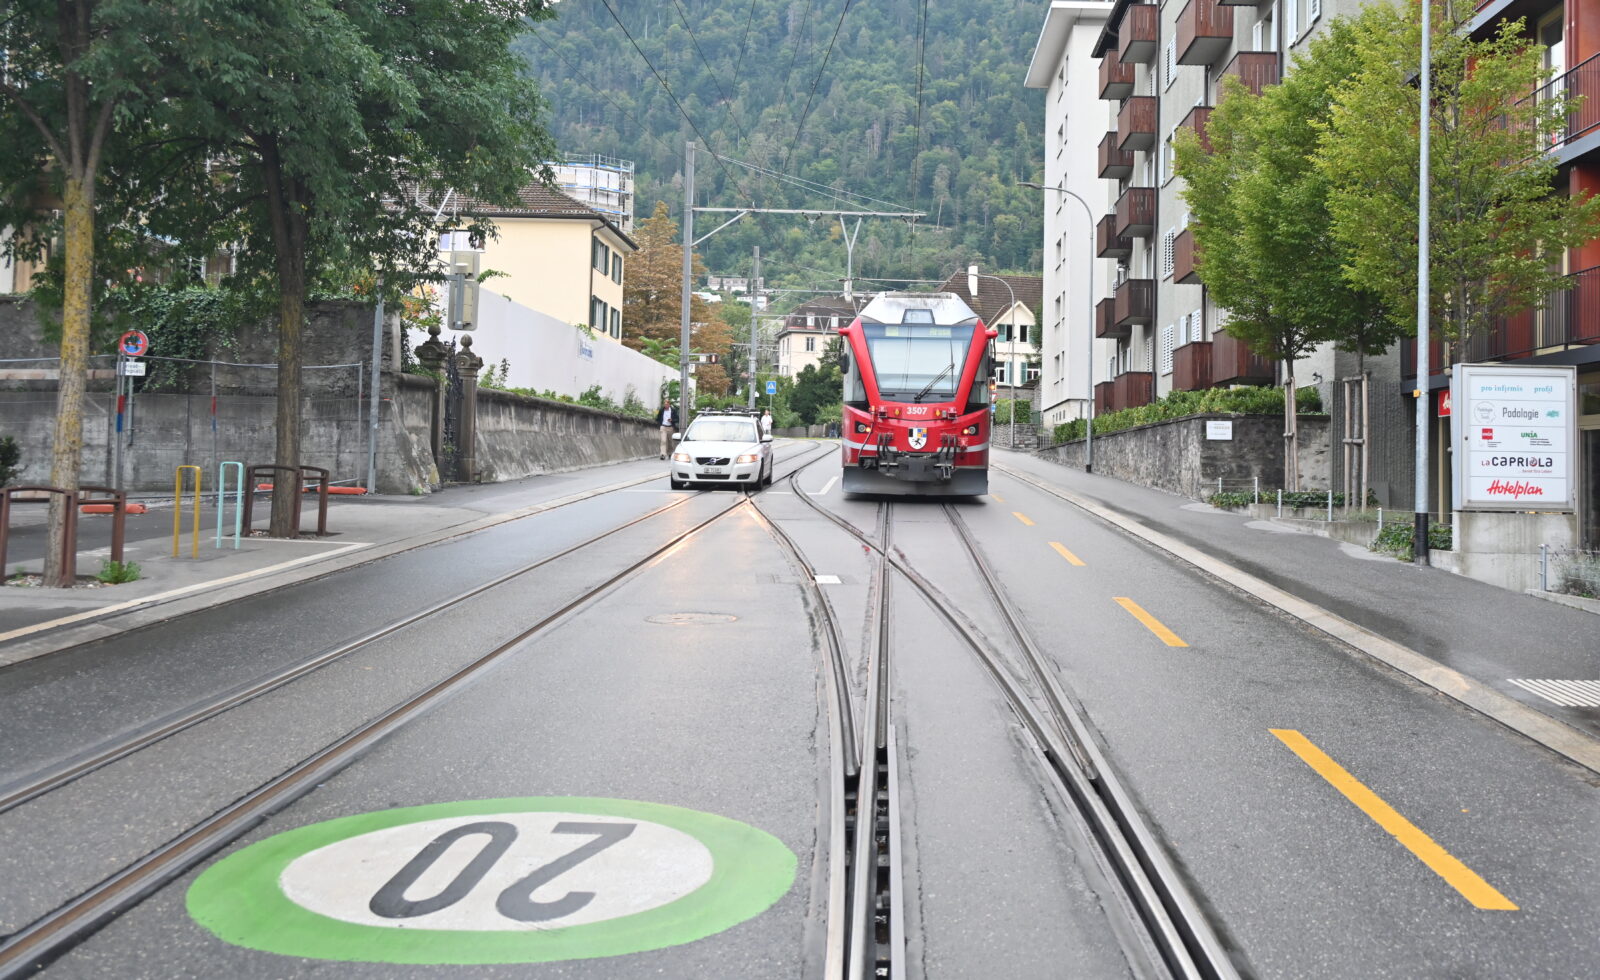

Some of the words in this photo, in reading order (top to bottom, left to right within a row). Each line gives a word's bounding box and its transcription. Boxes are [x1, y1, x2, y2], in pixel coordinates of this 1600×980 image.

[907, 406, 928, 415] 3507
[1502, 407, 1539, 420] Podologie
[1487, 480, 1543, 499] Hotelplan
[368, 820, 637, 923] 20
